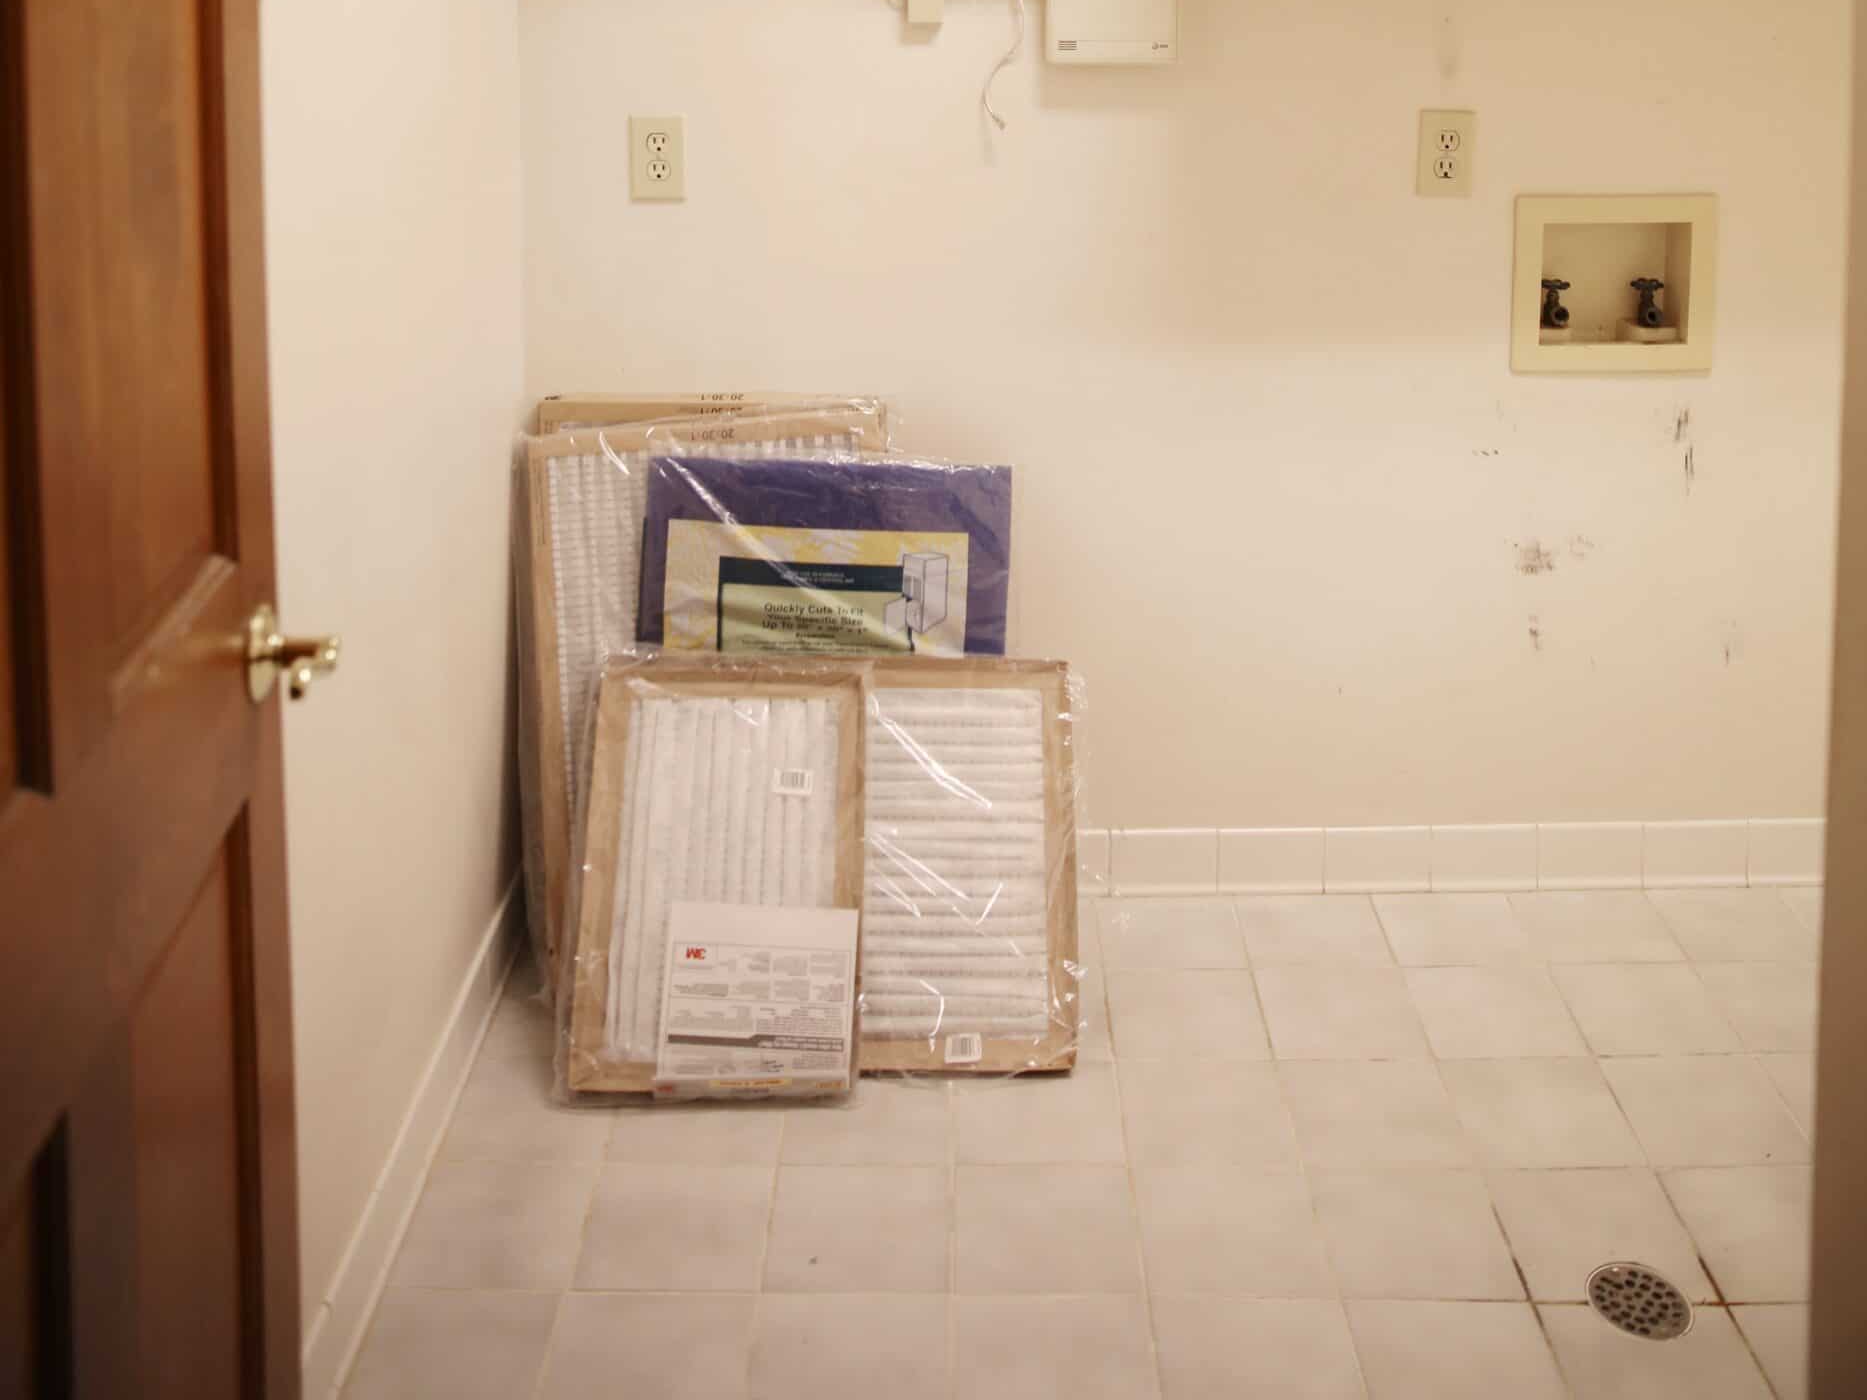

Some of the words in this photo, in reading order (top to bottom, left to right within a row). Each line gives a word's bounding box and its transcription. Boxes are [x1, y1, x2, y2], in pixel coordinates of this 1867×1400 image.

[763, 602, 805, 615] Quickly
[808, 604, 833, 614] Cuts
[762, 619, 778, 630] Up
[685, 946, 707, 961] 3M
